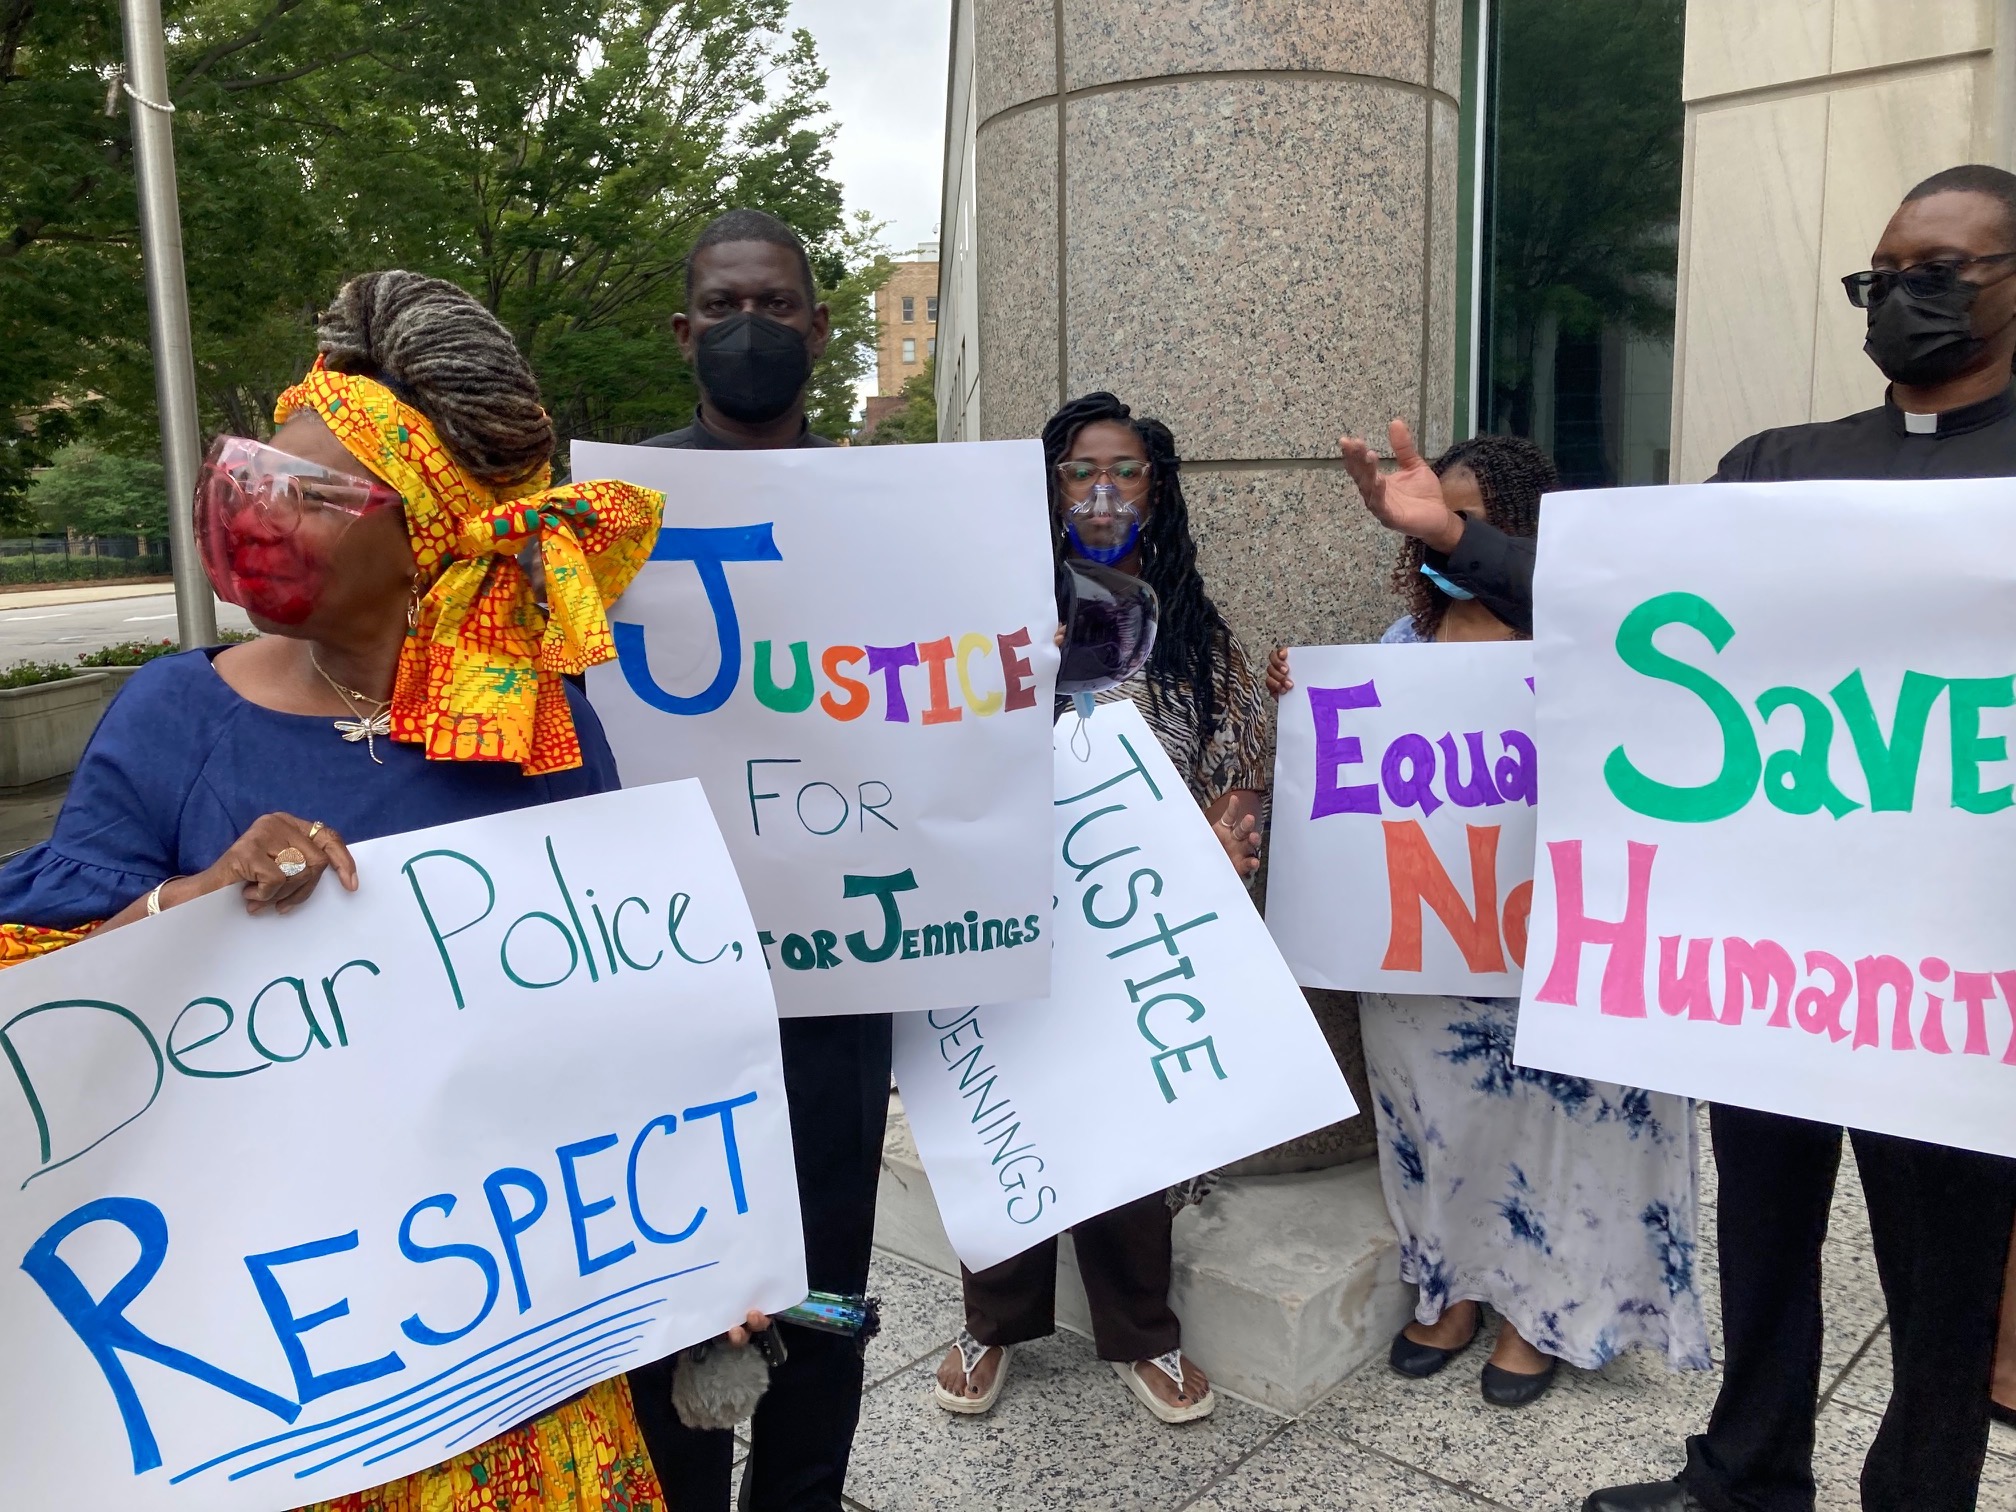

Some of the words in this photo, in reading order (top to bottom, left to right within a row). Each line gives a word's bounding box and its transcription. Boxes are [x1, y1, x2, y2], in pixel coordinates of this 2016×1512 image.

[613, 522, 1037, 725] JUSTICE
[746, 758, 898, 836] FOR
[1307, 676, 1538, 820] Equa
[1, 959, 381, 1190] Dear
[402, 835, 744, 1010] Police,
[927, 1005, 1057, 1225] JENNINGS
[20, 1091, 758, 1475] RESPECT
